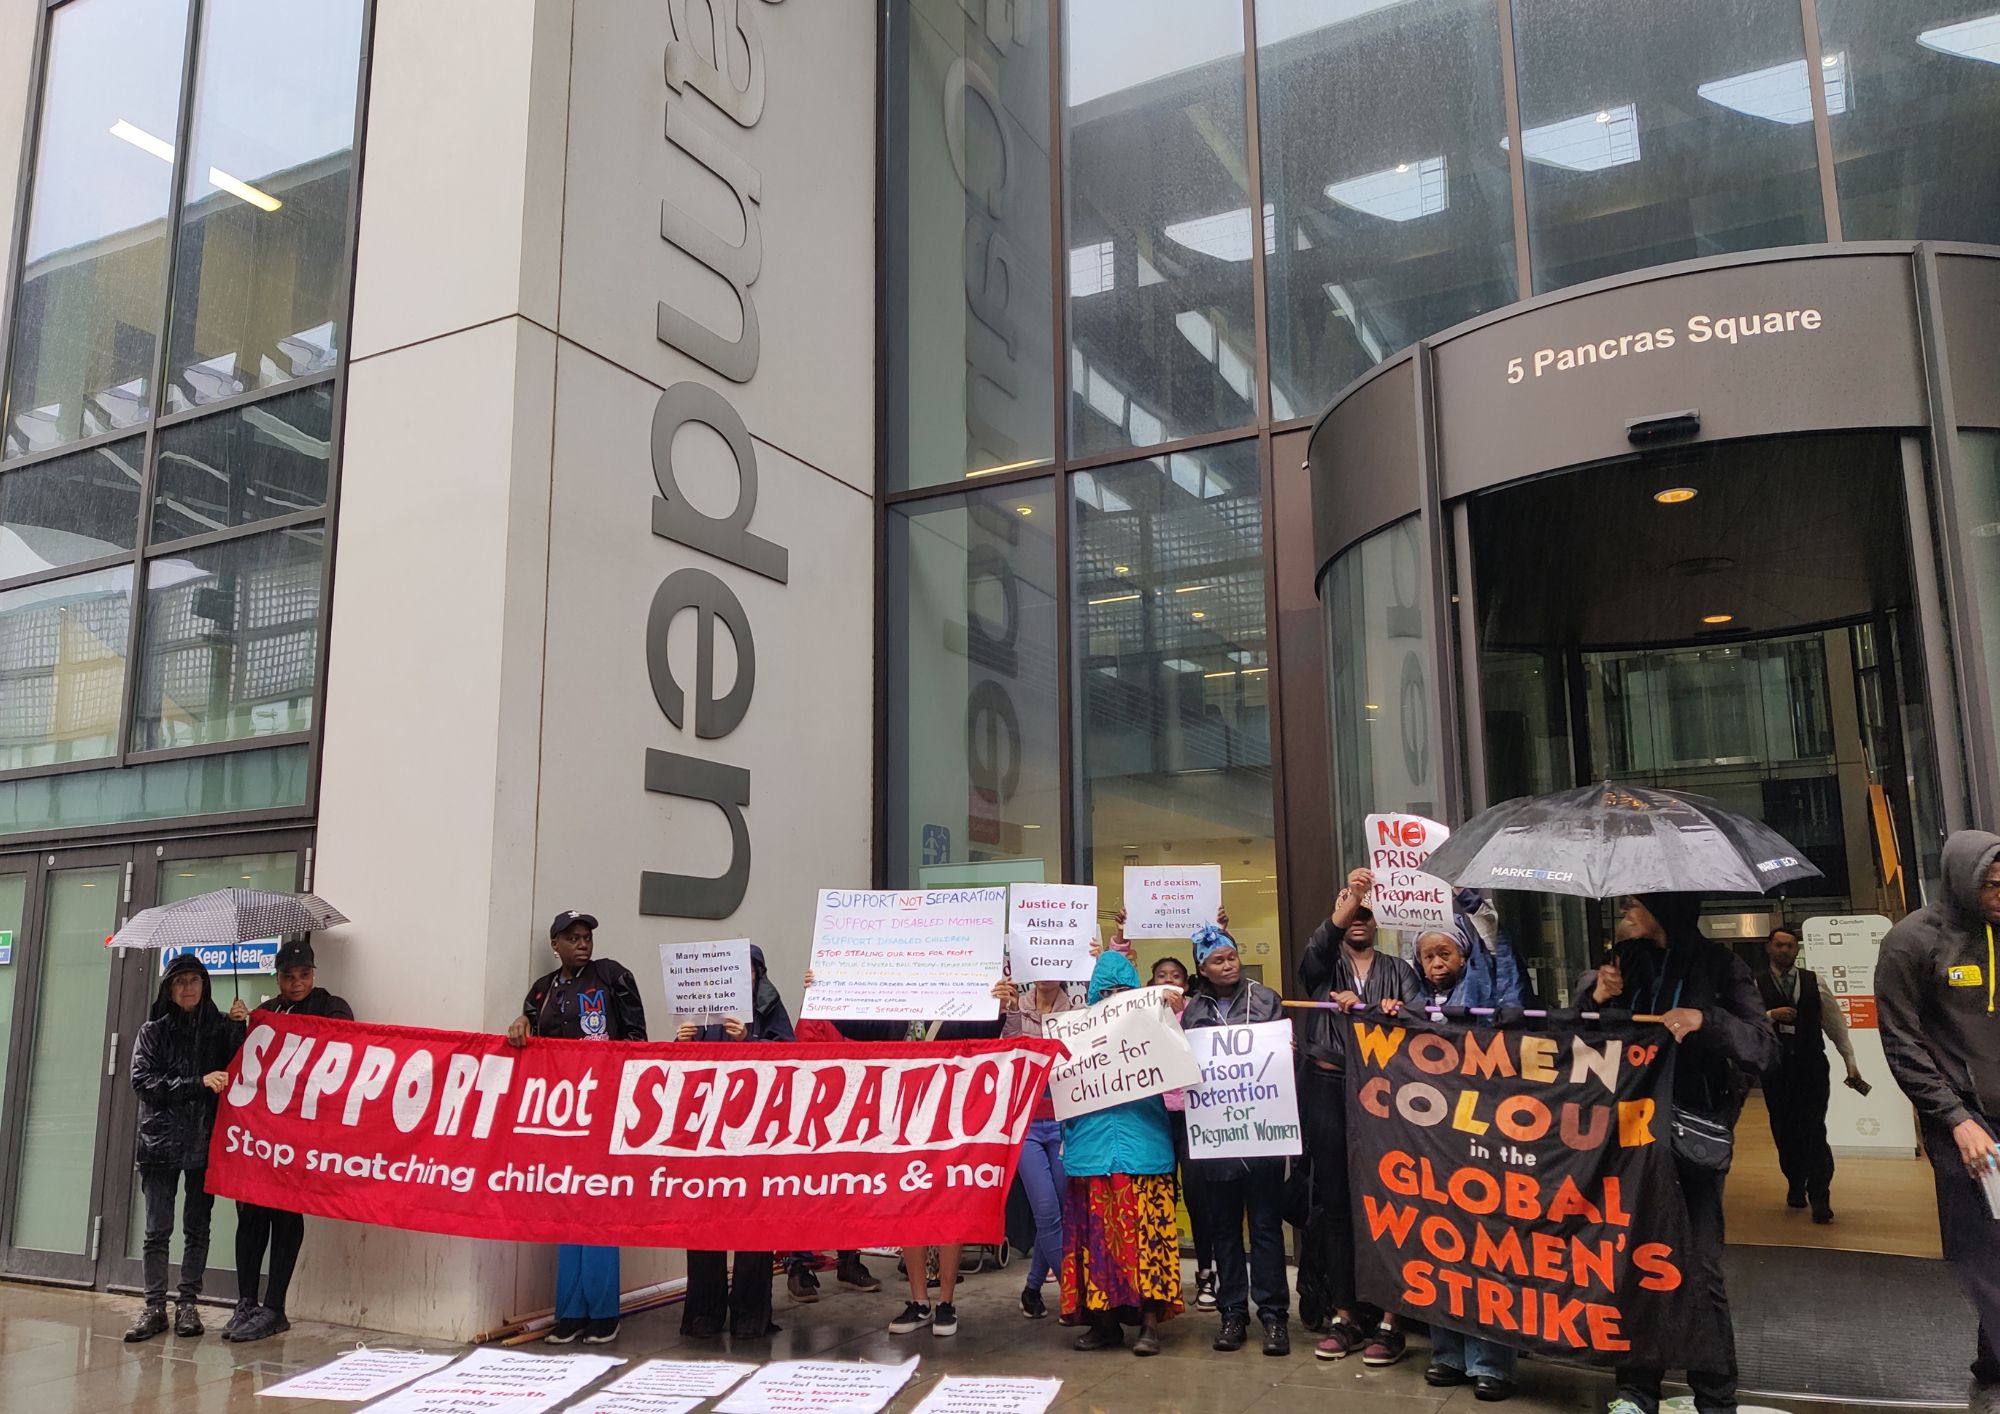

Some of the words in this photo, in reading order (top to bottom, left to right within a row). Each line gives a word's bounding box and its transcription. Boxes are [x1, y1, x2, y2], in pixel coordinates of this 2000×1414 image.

[1506, 357, 1524, 384] 5
[1534, 327, 1676, 377] Pancras
[1687, 308, 1823, 344] Square
[639, 0, 788, 920] amden
[1377, 820, 1426, 847] NO
[1144, 879, 1162, 887] End
[826, 892, 898, 908] SUPPORT
[899, 896, 923, 907] NOT
[925, 889, 1006, 905] SEPARATION
[1373, 883, 1445, 906] Pregnant
[1018, 899, 1067, 909] Justice
[1070, 900, 1089, 909] for
[1154, 907, 1191, 916] against
[1382, 904, 1444, 921] Women
[823, 915, 885, 930] SUPPORT
[891, 917, 944, 929] DISABLED
[948, 917, 994, 927] MOTHERS
[1026, 918, 1064, 928] Aisha
[1068, 919, 1078, 928] &
[1165, 921, 1203, 929] leavers.
[821, 934, 874, 945] SUPPORT
[924, 935, 970, 943] CHILDREN
[1029, 936, 1075, 946] Rianna
[194, 947, 227, 968] Keep
[230, 946, 263, 964] clear
[675, 952, 699, 960] Many
[702, 950, 731, 959] mums
[816, 949, 842, 957] STOP
[844, 949, 884, 957] STEALING
[946, 949, 974, 957] PROFIT
[685, 964, 740, 974] themselves
[1030, 957, 1073, 968] Cleary
[704, 977, 733, 986] social
[675, 992, 712, 1000] workers
[714, 991, 736, 999] take
[675, 1005, 695, 1013] their
[807, 1003, 850, 1012] SUPPORT
[874, 1006, 924, 1014] SEPARATION
[1045, 1016, 1098, 1040] Prison
[1100, 1003, 1122, 1023] for
[1126, 990, 1164, 1013] moth
[1212, 1028, 1254, 1057] NO
[1052, 1051, 1112, 1082] Torture
[1119, 1039, 1151, 1064] for
[1353, 1023, 1623, 1094] WOMEN
[1627, 1044, 1659, 1067] OF
[227, 1024, 515, 1139] SUPPORT
[516, 1067, 599, 1132] not
[1070, 1066, 1165, 1103] children
[1186, 1082, 1279, 1110] Detention
[1223, 1105, 1256, 1123] for
[1358, 1076, 1656, 1150] COLOUR
[1189, 1123, 1250, 1149] Pregnant
[1253, 1118, 1300, 1142] Women
[1470, 1138, 1490, 1160] in
[1500, 1144, 1537, 1167] the
[226, 1125, 295, 1168] Stop
[305, 1149, 476, 1193] snatching
[487, 1162, 634, 1197] children
[649, 1166, 746, 1199] from
[761, 1168, 887, 1198] mums
[899, 1160, 932, 1192] &
[947, 1163, 1005, 1189] na
[1378, 1150, 1631, 1227] GLOBAL
[1362, 1195, 1683, 1293] WOMEN'S
[1402, 1260, 1631, 1351] STRIKE
[479, 1365, 550, 1373] Council
[501, 1357, 575, 1365] Camden
[792, 1373, 849, 1382] belong
[766, 1388, 806, 1396] They
